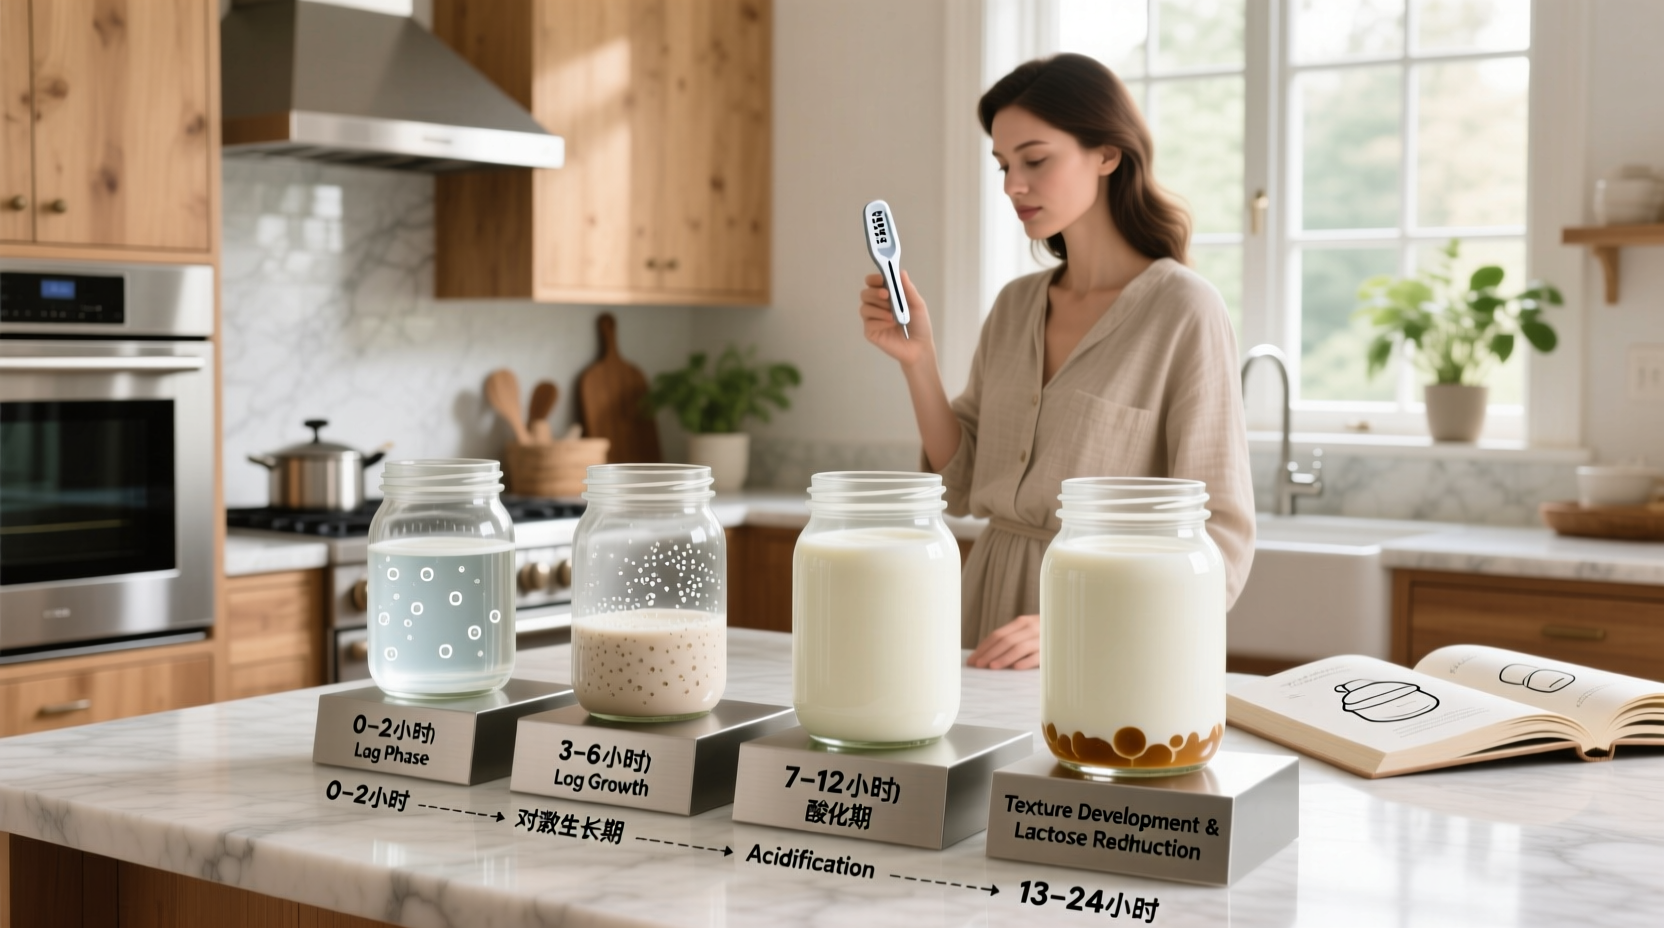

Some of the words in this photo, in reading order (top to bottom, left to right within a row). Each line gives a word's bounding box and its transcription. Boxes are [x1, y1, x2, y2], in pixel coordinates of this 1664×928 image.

[354, 741, 381, 764] Lag
[384, 744, 430, 765] Phase
[554, 768, 585, 792] Log
[588, 772, 649, 797] Growth
[1004, 794, 1074, 819] Texture
[1077, 803, 1200, 834] Development
[1205, 818, 1220, 837] &
[1014, 821, 1088, 847] Lactose
[745, 843, 875, 879] Acidification
